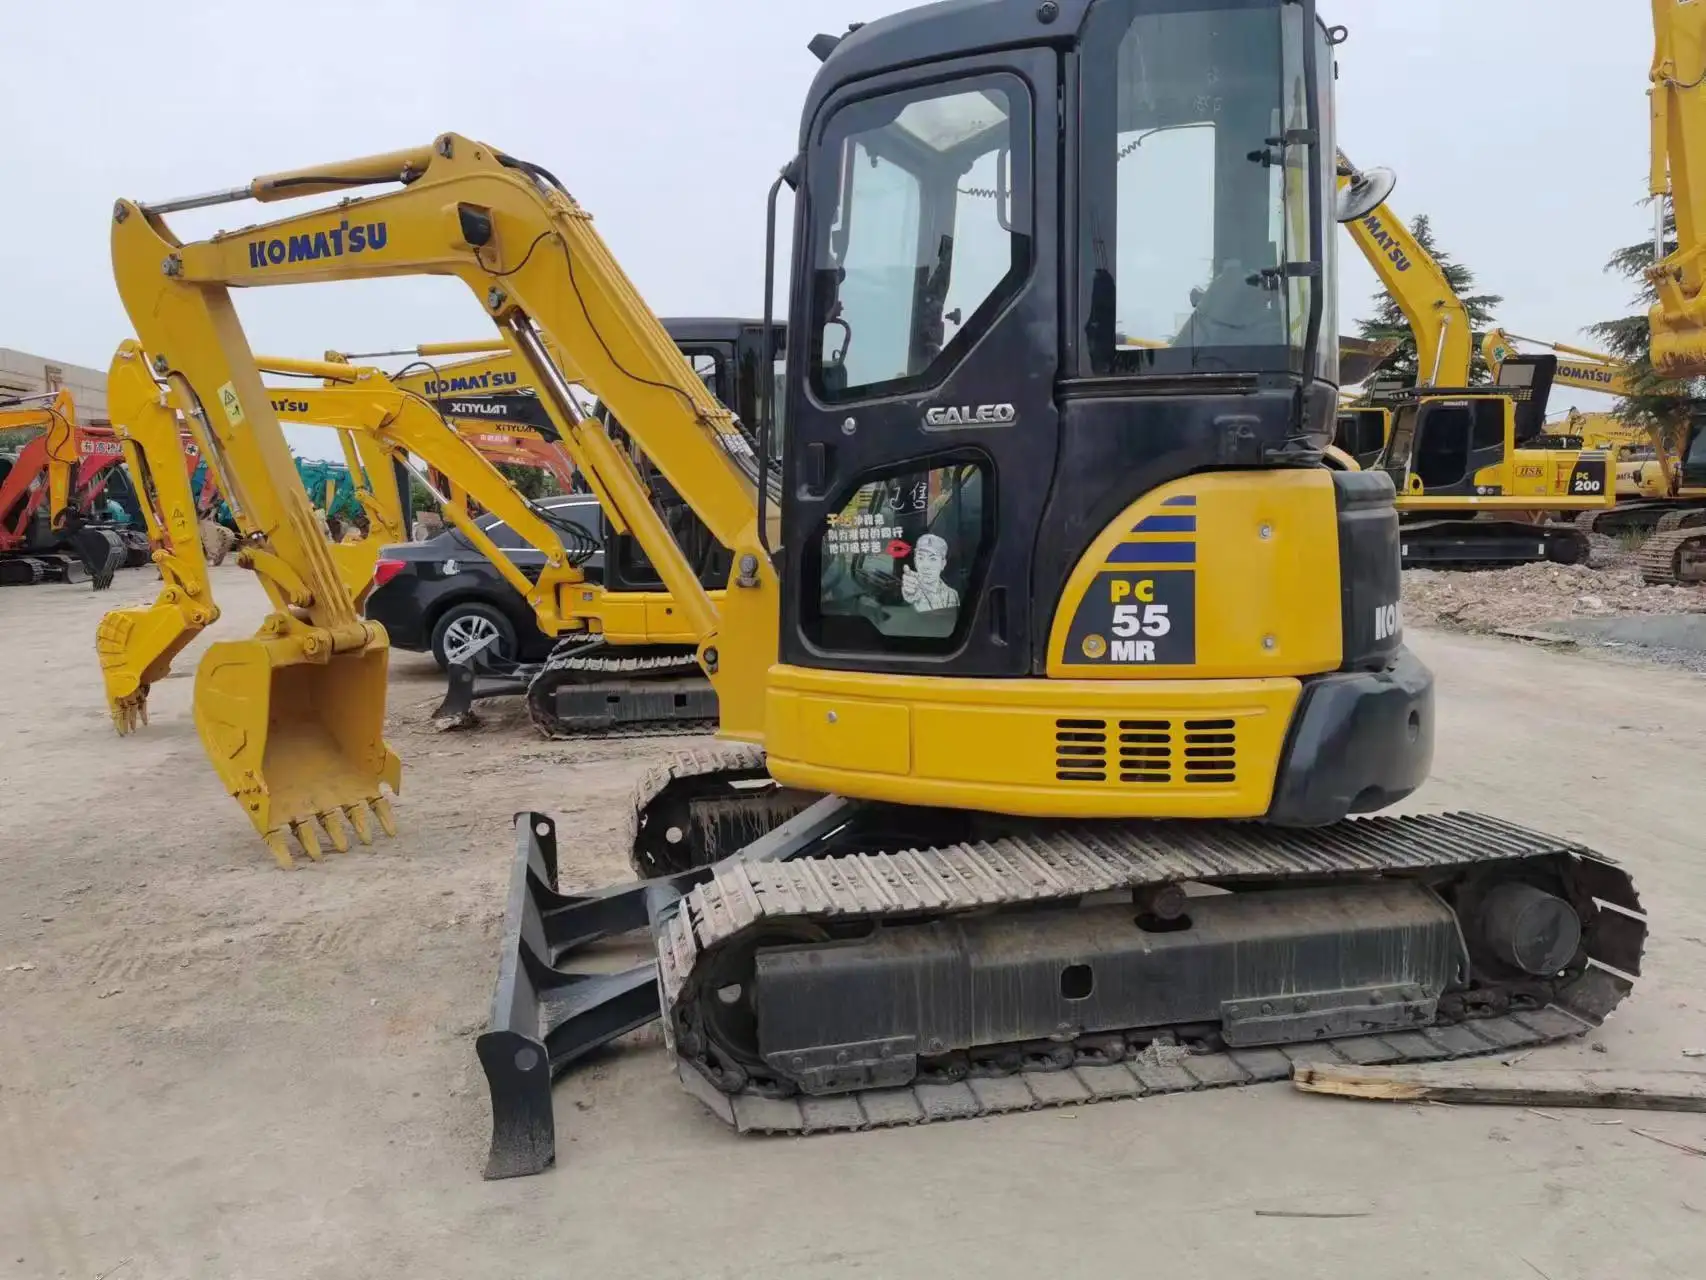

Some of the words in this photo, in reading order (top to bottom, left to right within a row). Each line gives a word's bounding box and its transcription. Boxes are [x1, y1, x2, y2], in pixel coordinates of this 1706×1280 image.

[249, 221, 387, 268] KOMATSU
[1364, 215, 1412, 272] MATSU
[424, 371, 516, 394] KOMATSU
[926, 403, 1015, 425] GALEO
[1574, 480, 1600, 492] 200
[1576, 472, 1589, 480] PC
[1110, 579, 1154, 603] PC
[1111, 604, 1171, 637] 55
[1111, 640, 1156, 661] MR
